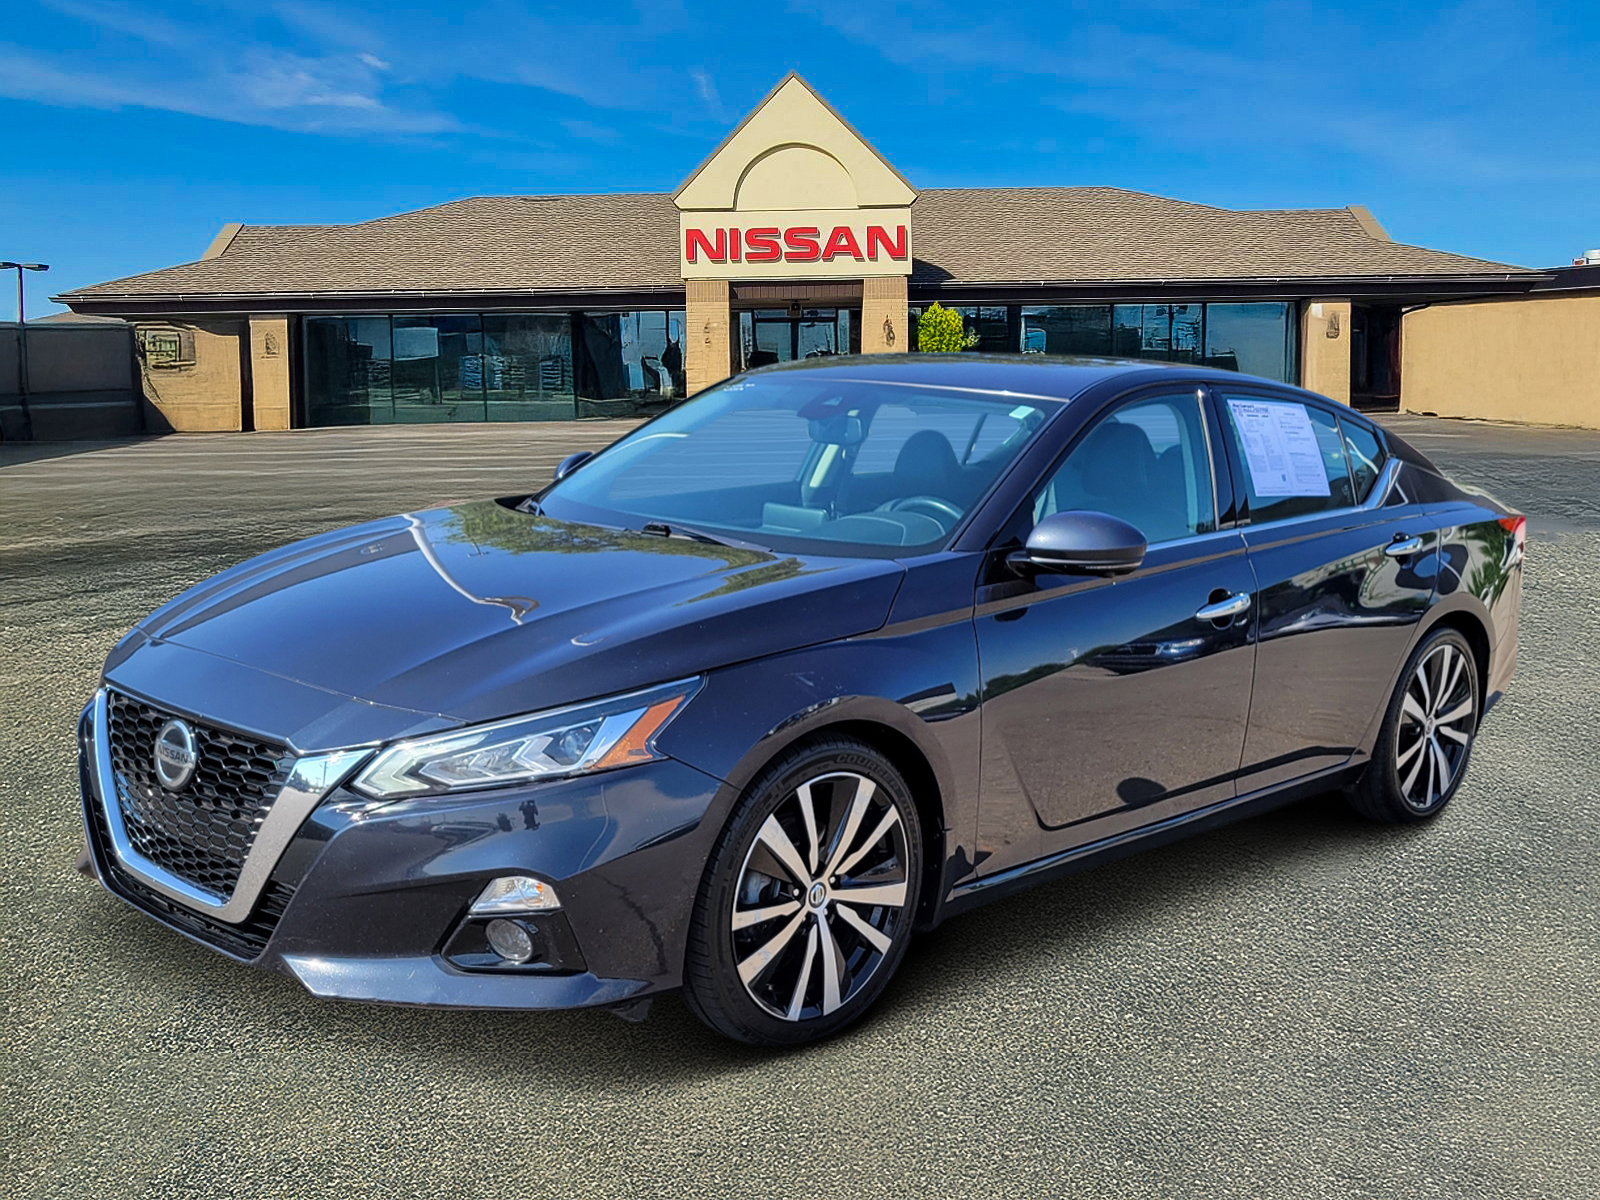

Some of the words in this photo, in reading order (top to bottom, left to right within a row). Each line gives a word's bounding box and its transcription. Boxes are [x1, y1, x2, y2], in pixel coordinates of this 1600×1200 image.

[686, 225, 907, 263] NISSAN
[158, 744, 189, 763] NISSAN
[837, 754, 900, 790] COURSER
